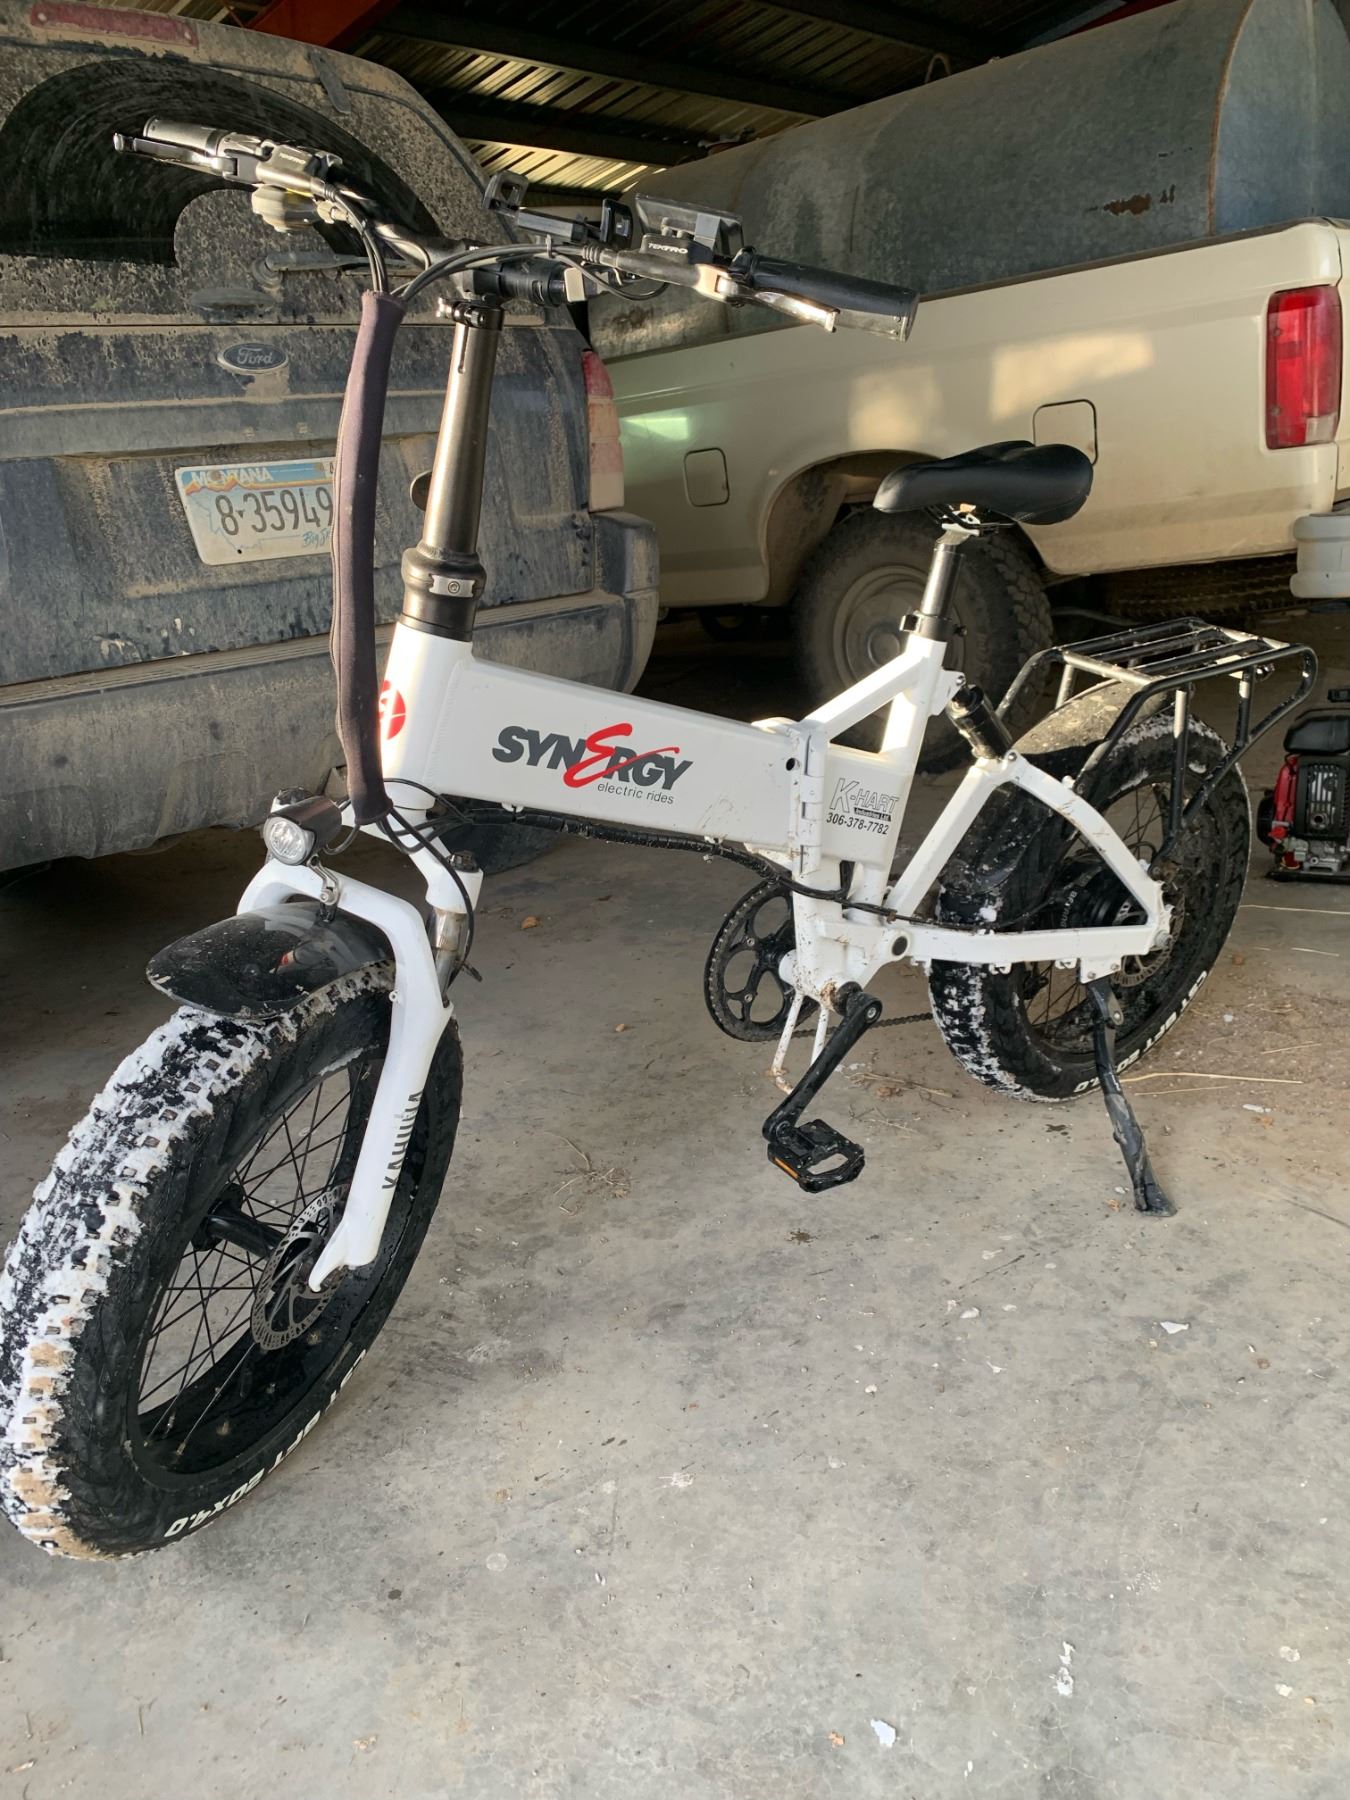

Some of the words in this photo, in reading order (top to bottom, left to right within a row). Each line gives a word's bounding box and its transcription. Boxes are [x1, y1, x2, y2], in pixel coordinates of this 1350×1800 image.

[648, 242, 688, 254] TEKTRO
[237, 346, 273, 365] Ford
[492, 723, 693, 790] SYNERGY
[597, 781, 642, 799] electric
[646, 791, 674, 805] rides
[826, 812, 889, 834] 306-378-7782
